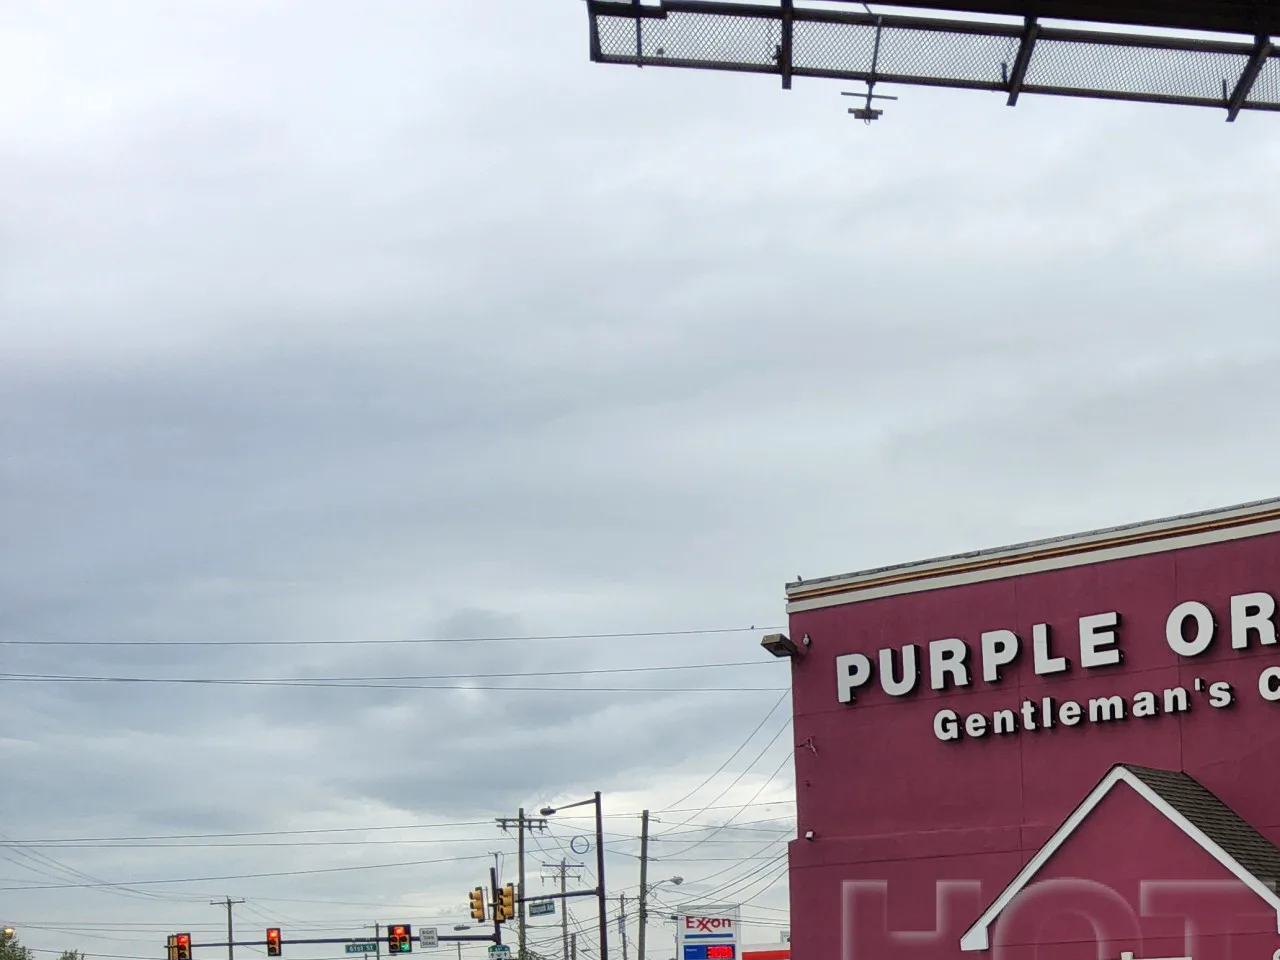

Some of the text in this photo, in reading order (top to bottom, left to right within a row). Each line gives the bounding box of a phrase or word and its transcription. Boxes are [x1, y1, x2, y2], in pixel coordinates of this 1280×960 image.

[835, 611, 1122, 704] PURPLE
[933, 676, 1232, 741] Gentleman's
[685, 916, 732, 932] Exxon
